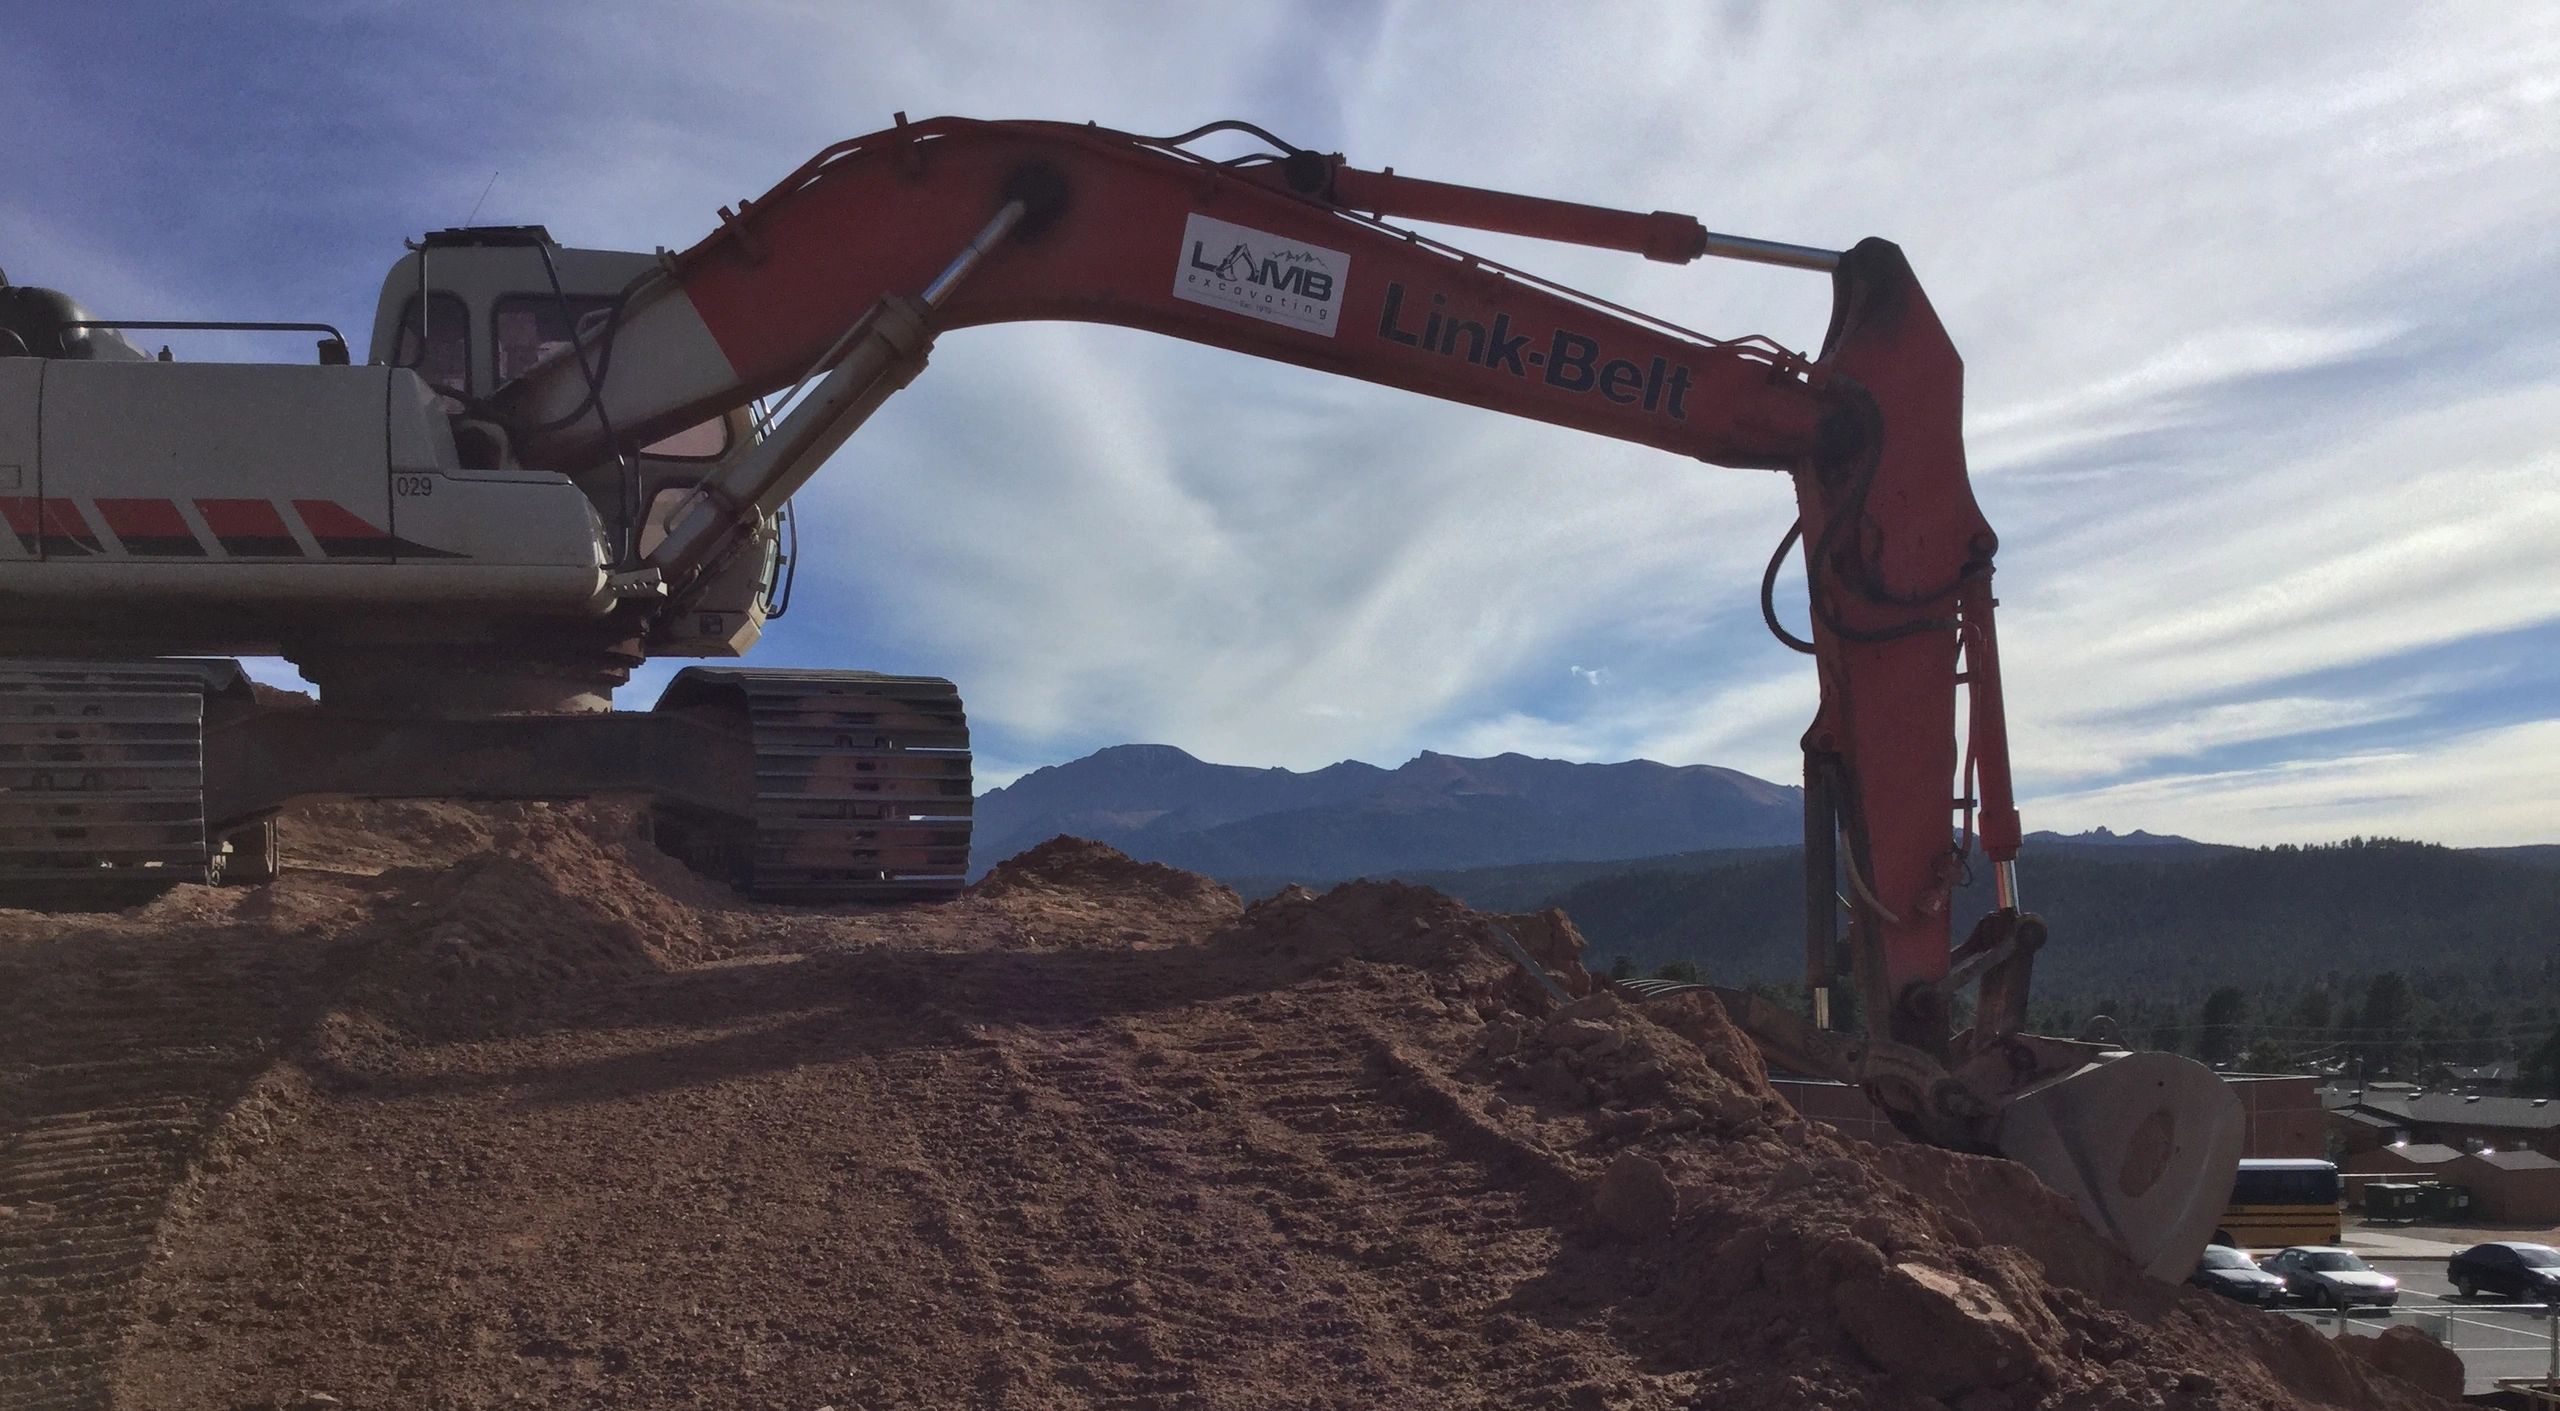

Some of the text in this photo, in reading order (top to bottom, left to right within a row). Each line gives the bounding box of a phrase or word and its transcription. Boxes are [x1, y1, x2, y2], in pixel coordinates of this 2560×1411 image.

[1188, 273, 1328, 319] excavating
[1191, 240, 1333, 301] LAMB
[1378, 280, 1693, 421] Link-Belt
[397, 477, 432, 496] 029
